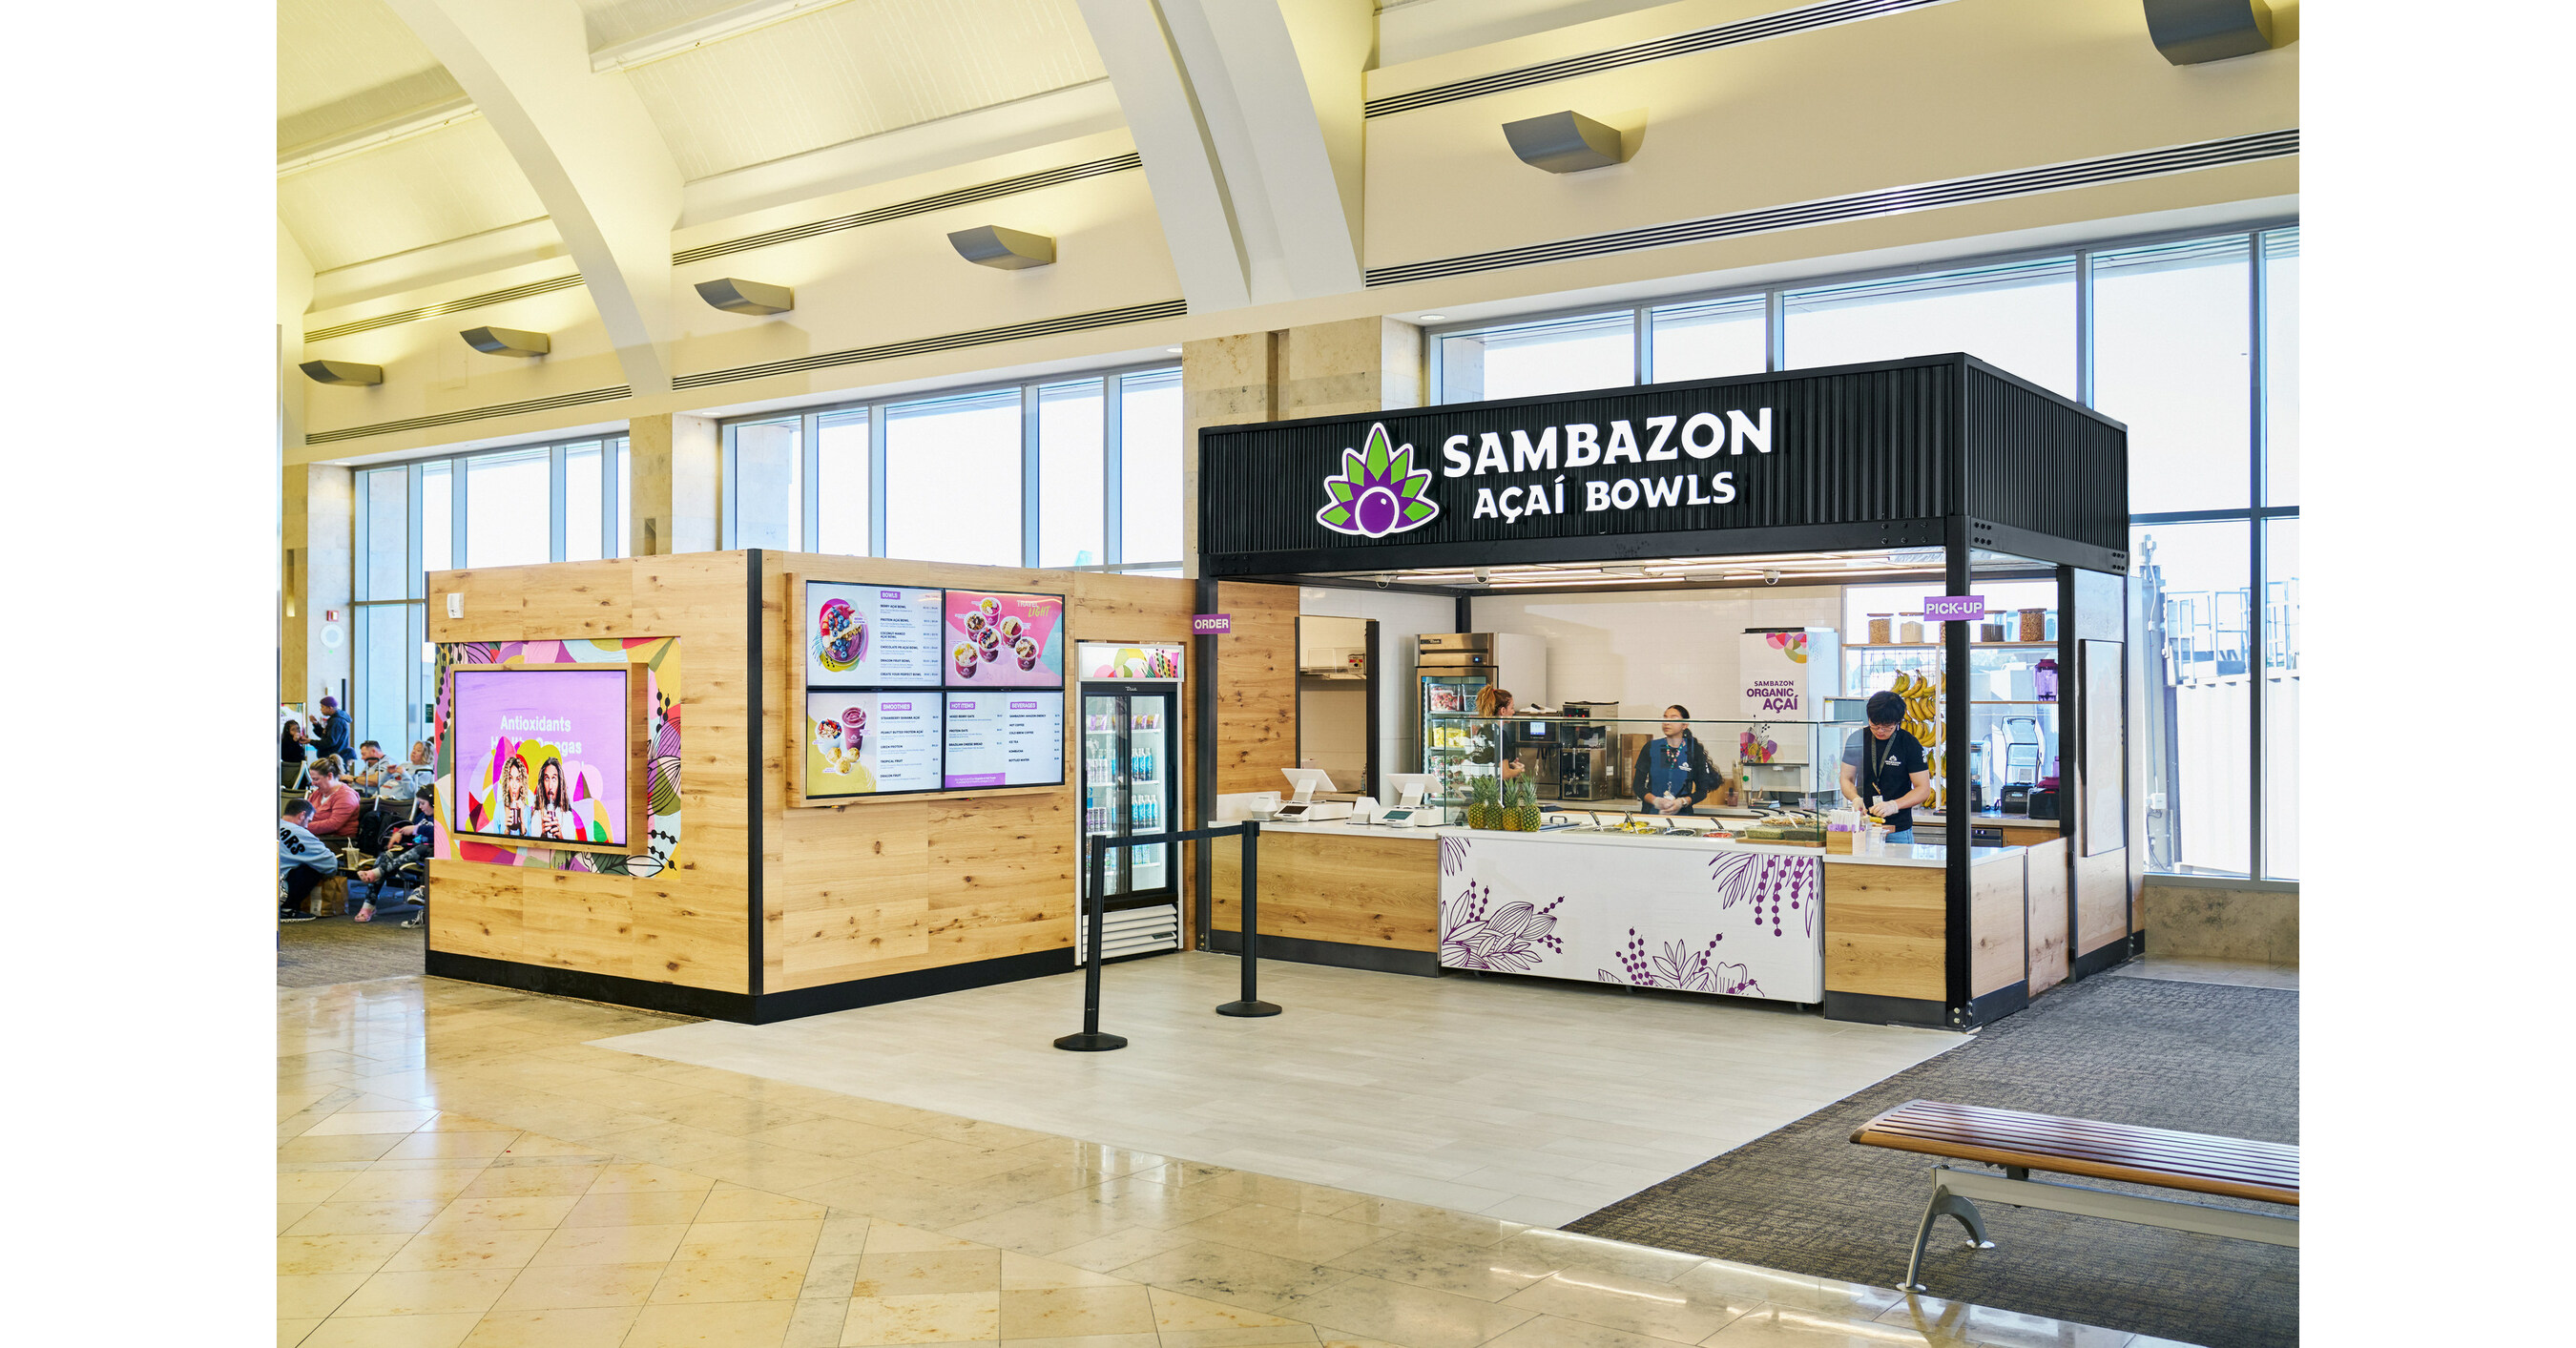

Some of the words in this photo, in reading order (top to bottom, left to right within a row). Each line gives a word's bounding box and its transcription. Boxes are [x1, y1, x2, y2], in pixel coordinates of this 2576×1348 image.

[1443, 407, 1773, 478] SAMBAZON
[1472, 474, 1567, 524] AÇAÍ
[1585, 471, 1736, 512] BOWLS
[1016, 599, 1038, 608] TRAVEL
[1925, 602, 1983, 614] PICK-UP
[1028, 606, 1051, 617] LIGHT
[1195, 618, 1229, 630] ORDER
[1746, 688, 1794, 697] ORGANIC
[1762, 695, 1798, 714] AÇAÍ
[500, 715, 571, 733] Antioxidants
[280, 827, 305, 855] ARS
